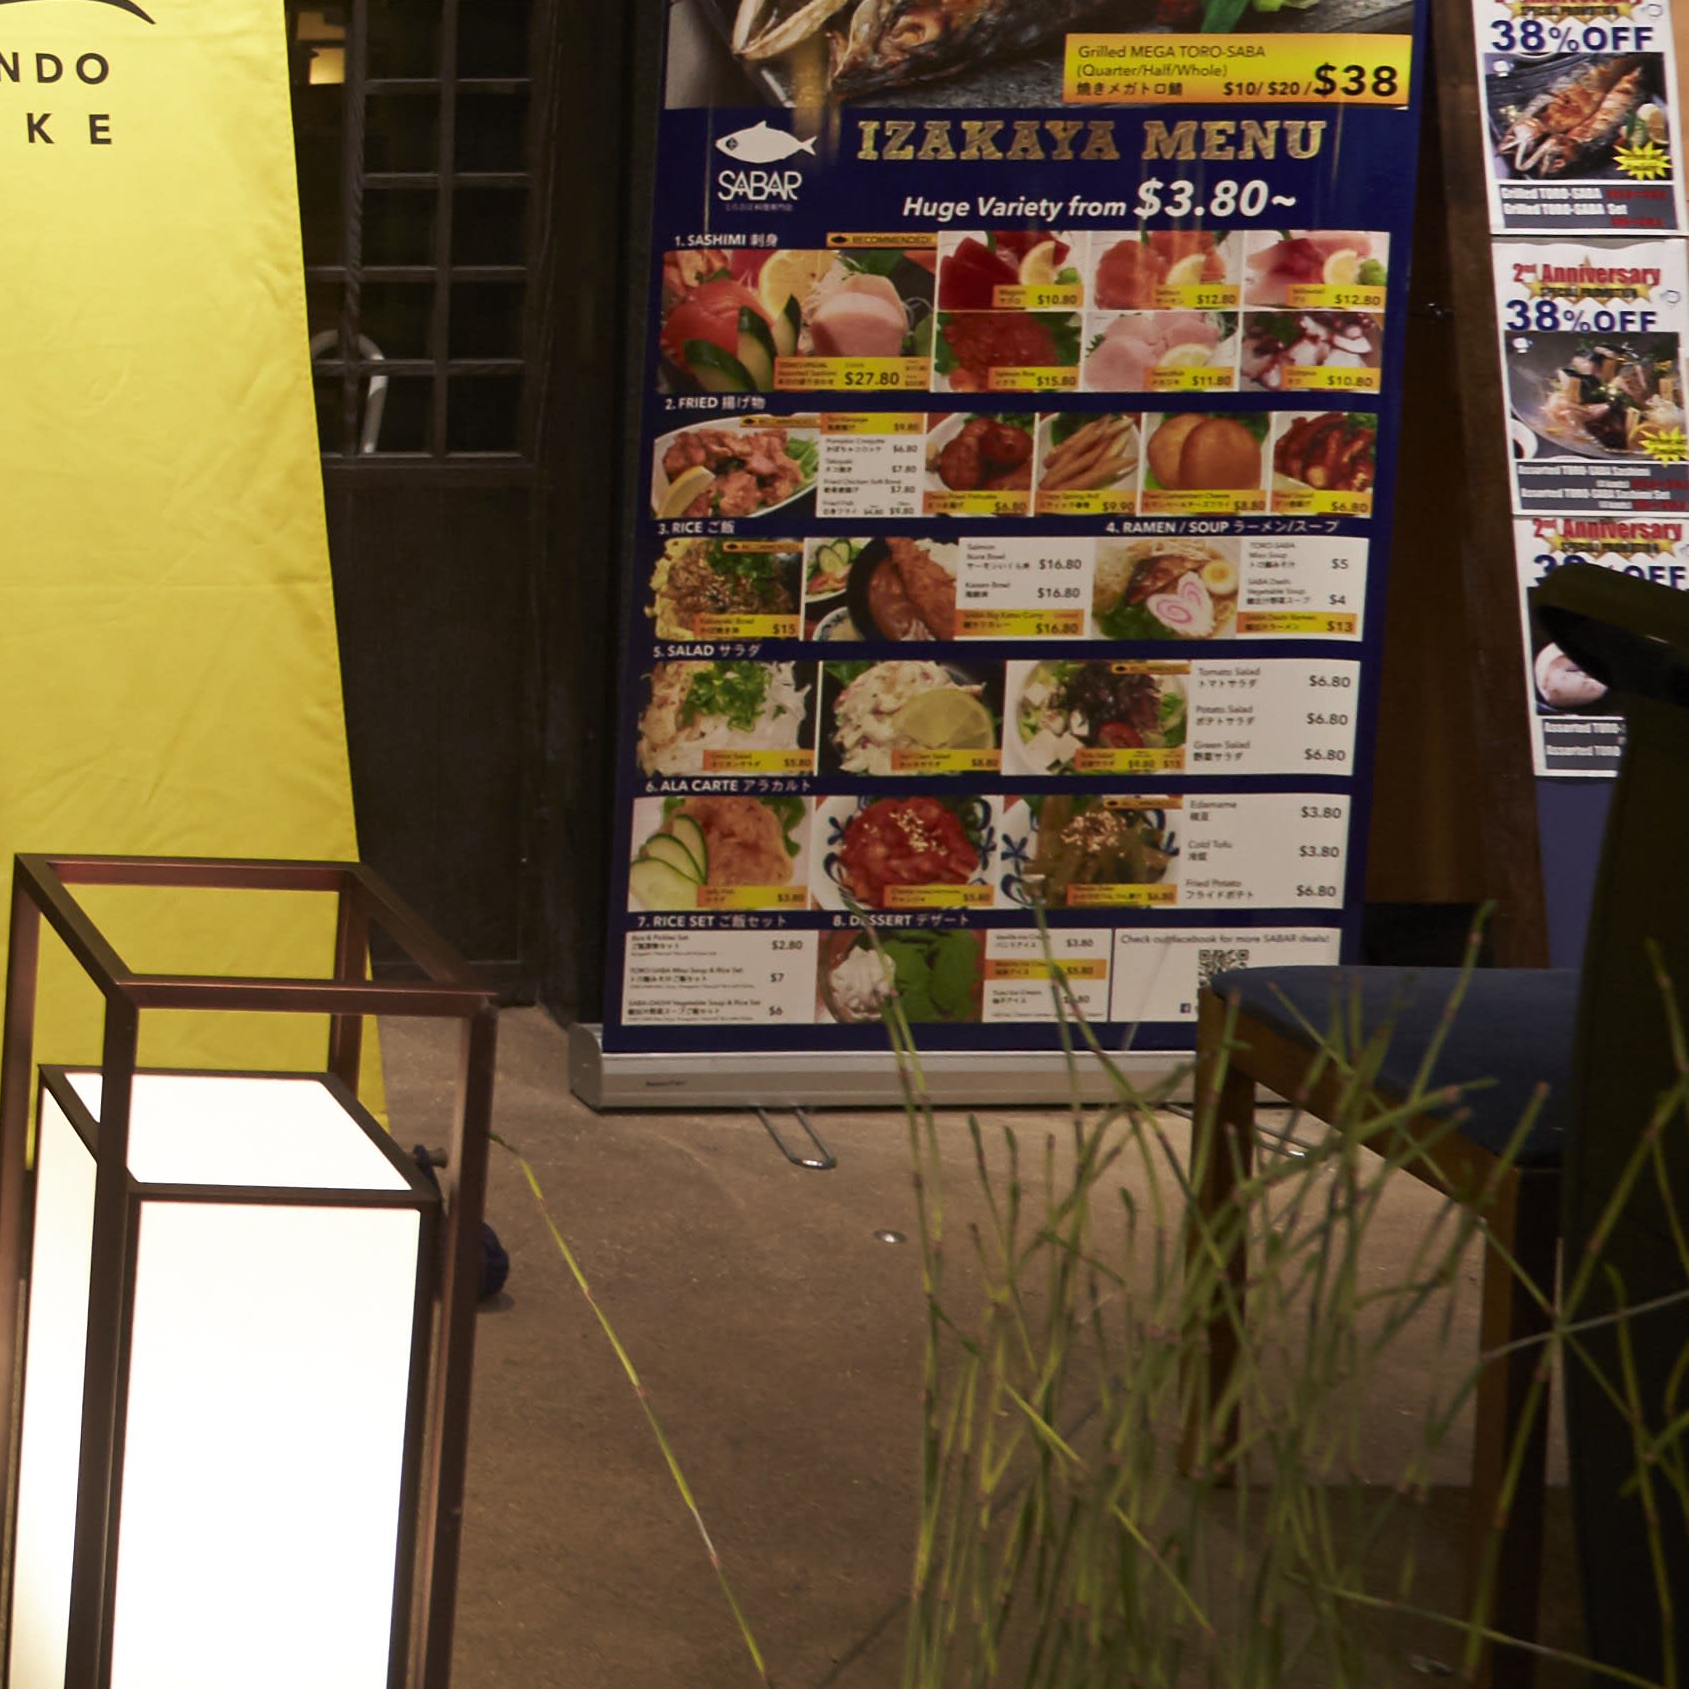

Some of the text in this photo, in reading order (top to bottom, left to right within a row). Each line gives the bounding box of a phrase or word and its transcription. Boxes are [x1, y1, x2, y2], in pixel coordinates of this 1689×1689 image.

[1078, 45, 1266, 59] Grilled MEGA TORO-SABA
[1077, 63, 1229, 78] (Quarter/Half/Whole)
[1267, 81, 1300, 97] $20
[1313, 62, 1399, 99] $38
[856, 120, 1328, 161] IZAKAYA MENU
[717, 170, 803, 201] SABAR
[902, 196, 970, 223] Huge
[976, 196, 1064, 223] Variety
[1067, 195, 1127, 217] from
[674, 233, 779, 248] 1. SASHIMI 刺身
[1541, 263, 1662, 287] Anniversary
[1196, 293, 1237, 305] $12.80
[1334, 293, 1381, 306] $12.80
[844, 371, 900, 386] $27.80
[1327, 375, 1373, 388] $10.80
[666, 397, 677, 410] 2.
[678, 396, 719, 409] FRIED
[658, 522, 670, 535] 3.
[672, 521, 703, 535] RICE
[1105, 521, 1121, 534] 4.
[1122, 521, 1176, 534] RAMEN
[1188, 521, 1230, 534] SOUP
[1563, 518, 1683, 542] Anniversary
[1038, 558, 1082, 571] $16.80
[1331, 558, 1350, 570] $5
[1036, 587, 1081, 599] $16.80
[1328, 594, 1347, 605] $4
[772, 624, 796, 635] $15
[1035, 623, 1078, 635] $16.80
[1327, 620, 1354, 633] $13
[652, 643, 762, 659] 5. SALAD サラダ
[1308, 674, 1351, 689] $6.80
[1306, 712, 1349, 726] $6.80
[1304, 748, 1347, 762] $6.80
[644, 779, 813, 793] 6. ALA CARTE アラカルト
[1300, 805, 1342, 819] $3.80
[1299, 845, 1340, 858] $3.80
[1296, 885, 1337, 898] $6.80
[638, 916, 651, 928] 7.
[653, 915, 687, 928] RICE
[689, 915, 715, 928] SET
[833, 915, 847, 928] 8.
[771, 940, 804, 950] $2.80
[769, 972, 785, 983] $7
